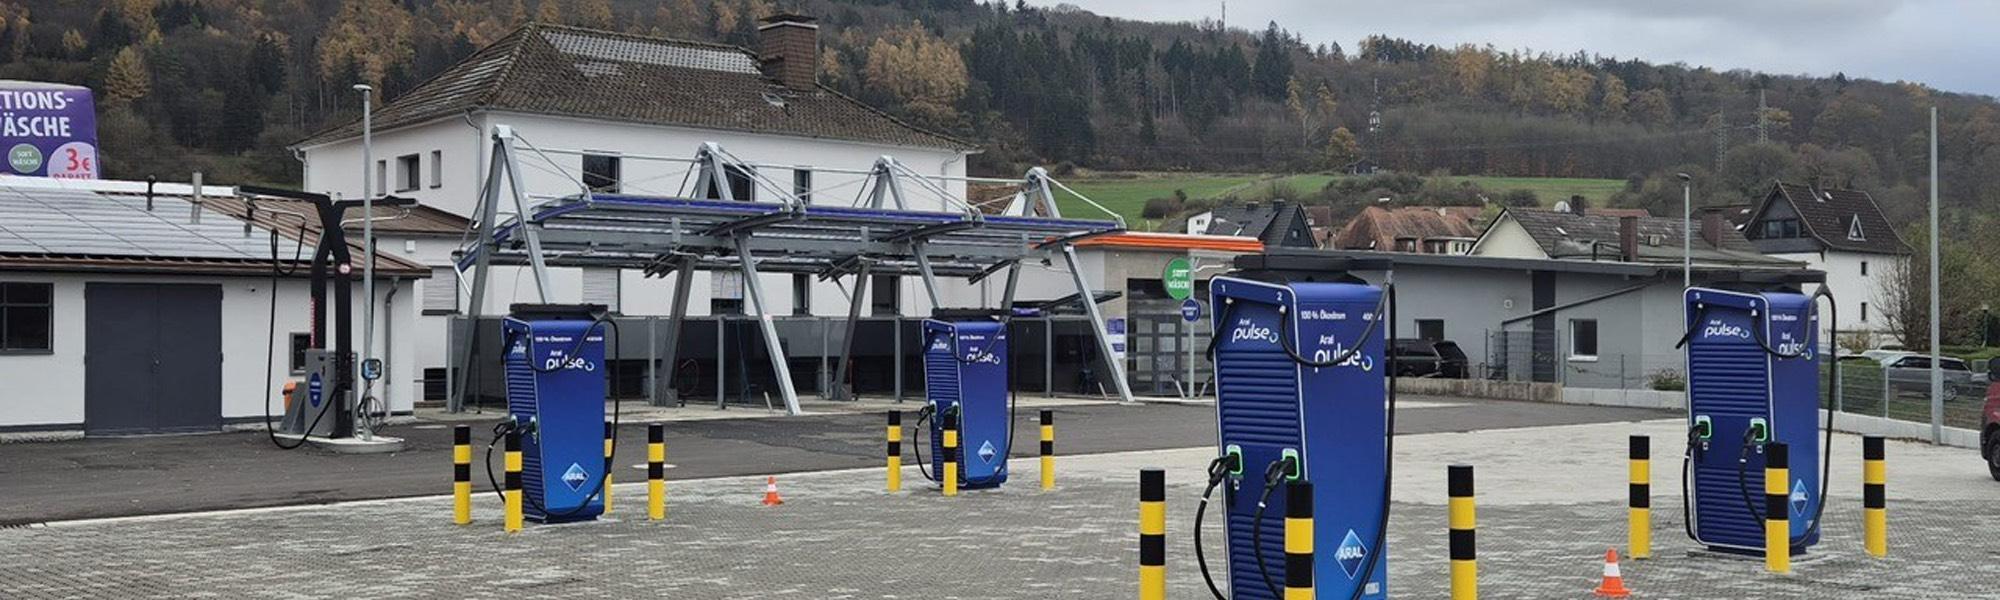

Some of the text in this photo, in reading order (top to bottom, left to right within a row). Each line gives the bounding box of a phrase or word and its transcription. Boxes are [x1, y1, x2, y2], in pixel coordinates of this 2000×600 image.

[0, 91, 74, 110] TIONS-
[0, 112, 72, 137] ÄSCHE
[1277, 291, 1283, 301] 2
[1232, 323, 1270, 343] pulse
[1704, 324, 1741, 338] pulse
[1319, 334, 1334, 345] Aral
[1339, 546, 1364, 560] ARAL
